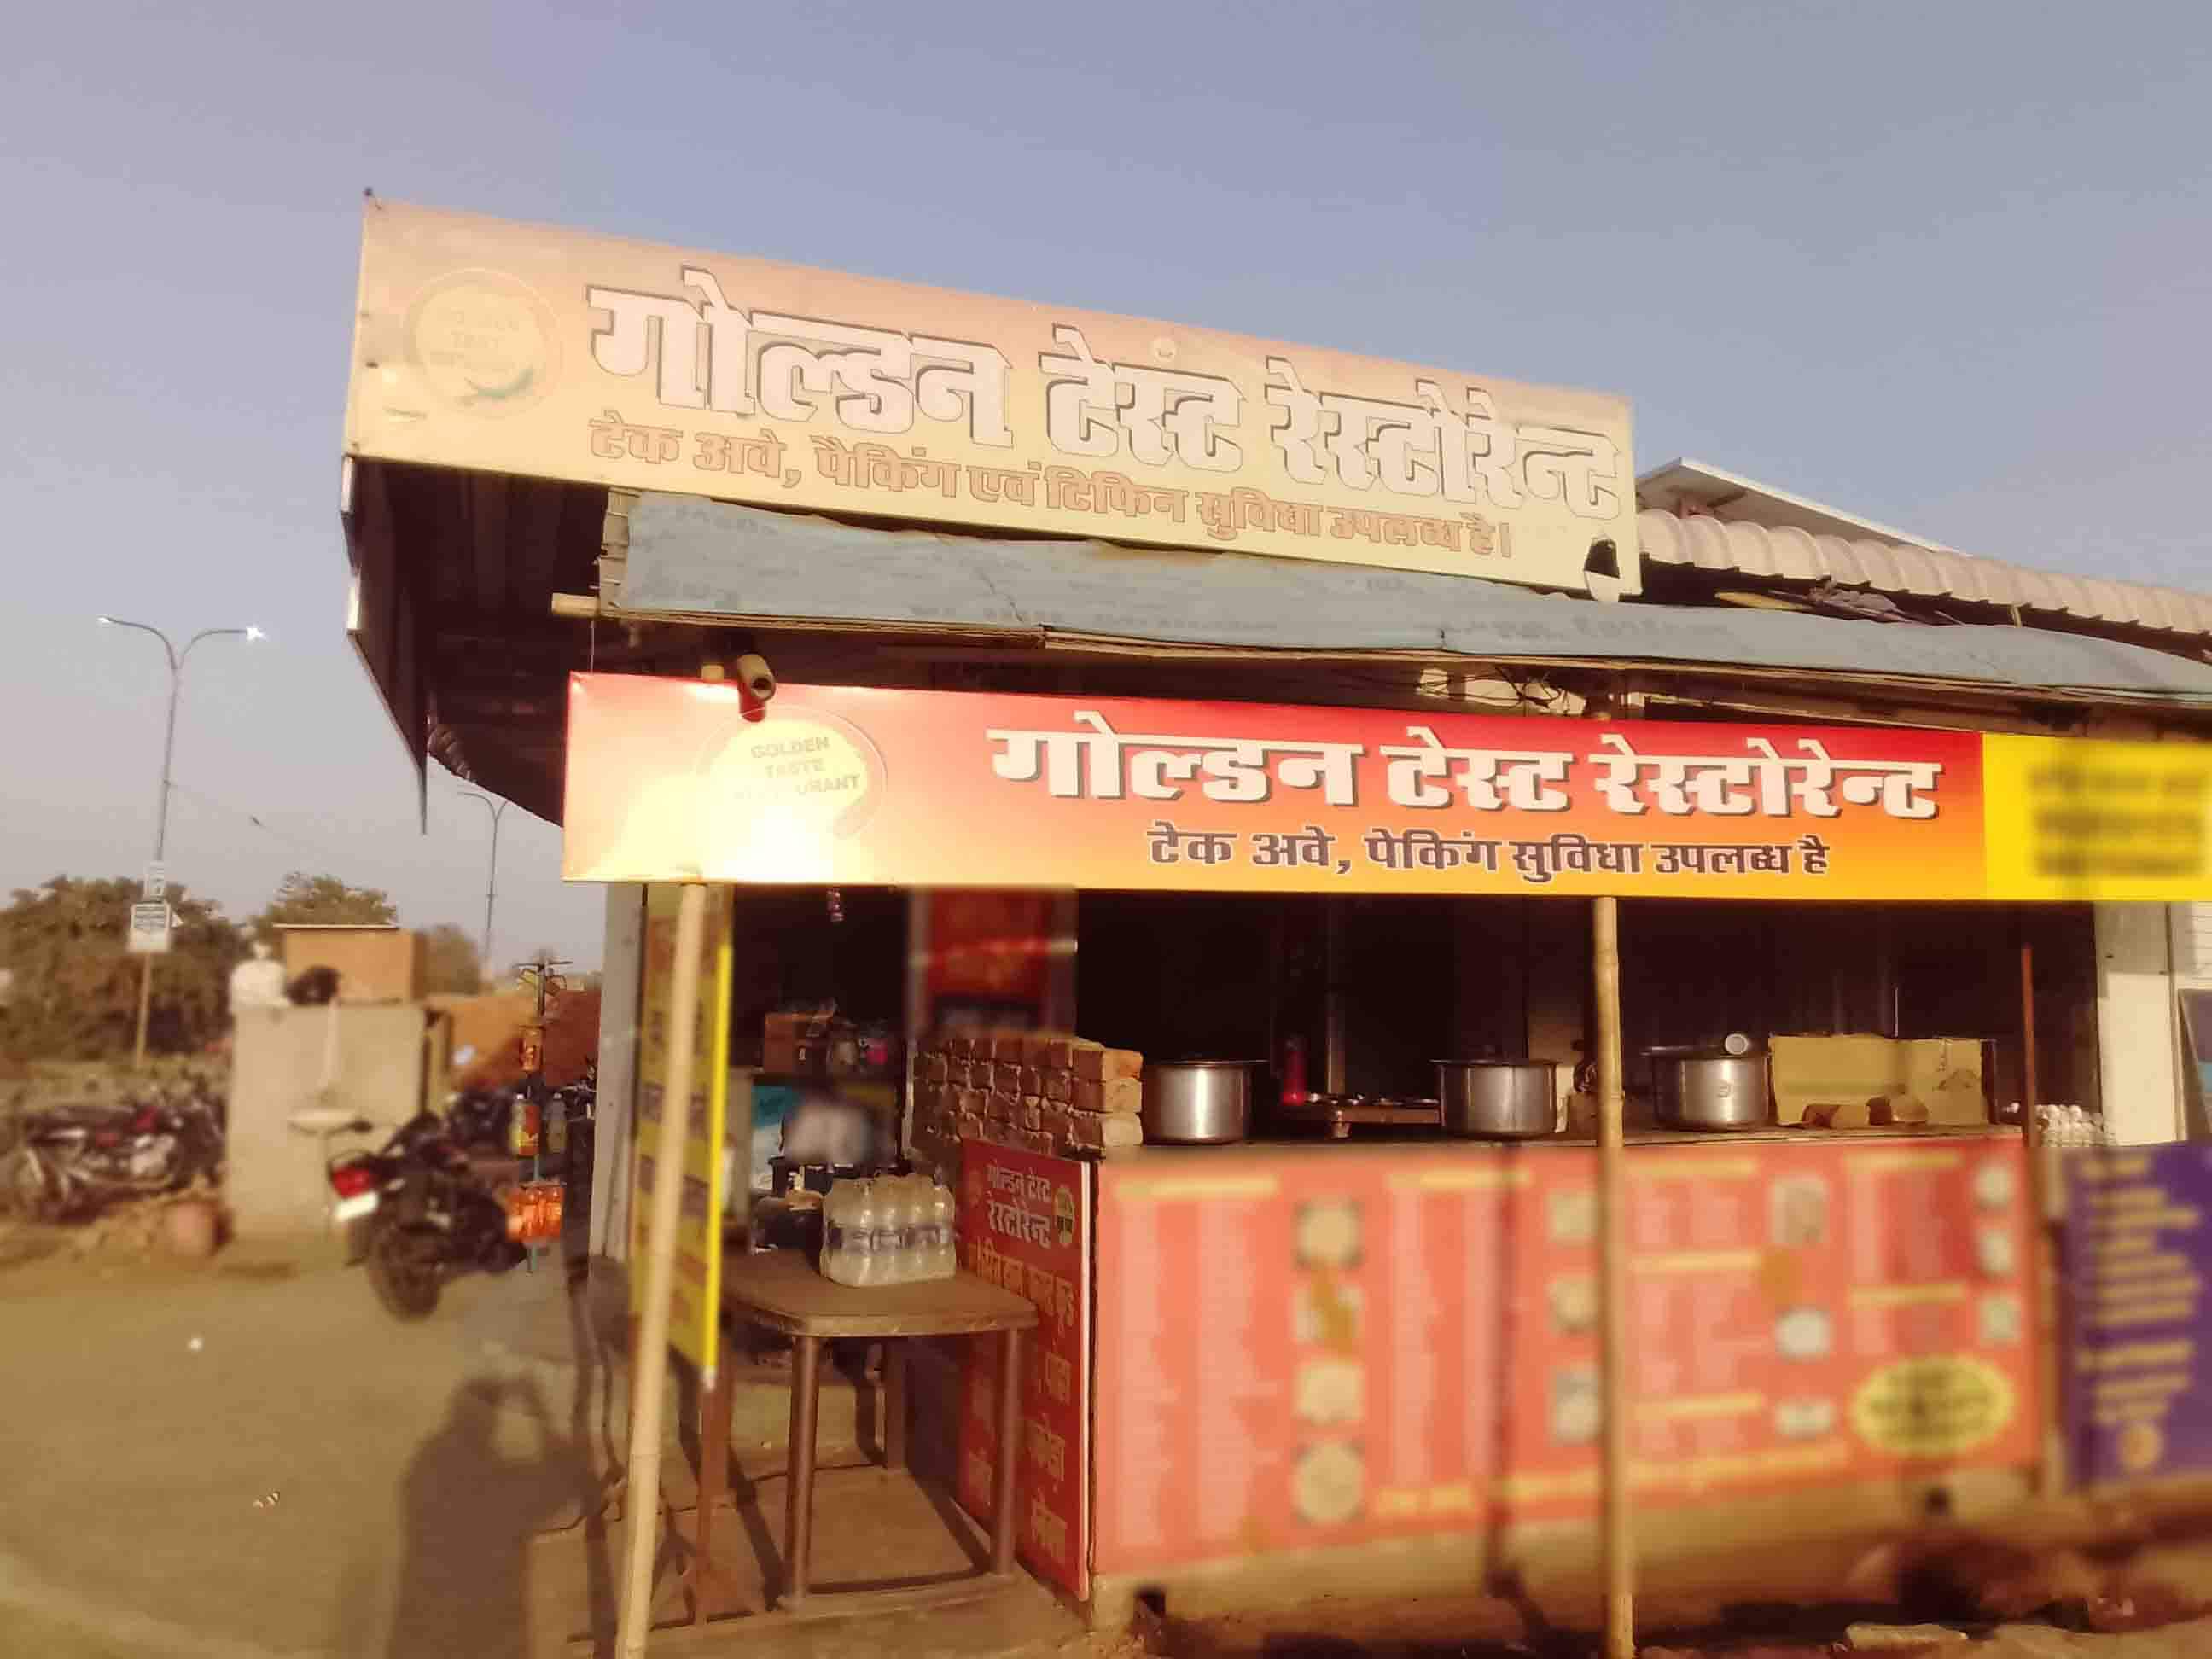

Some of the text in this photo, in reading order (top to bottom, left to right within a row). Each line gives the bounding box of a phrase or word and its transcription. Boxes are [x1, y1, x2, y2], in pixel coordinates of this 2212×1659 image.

[586, 263, 1622, 521] गोल्डन टेस्ट रेस्टोरेन्ट
[587, 408, 683, 464] टेक
[808, 434, 962, 498] पैकिंग
[965, 459, 1043, 507] एवं
[1044, 465, 1190, 523] टिफिन
[1195, 486, 1324, 541] सुविधा
[1325, 506, 1464, 552] उपलब्ध
[751, 736, 830, 758] GOLDEN
[987, 710, 1944, 819] गोल्डन टेस्ट रेस्टोरेन्ट
[1147, 820, 1237, 865] टेक
[1364, 828, 1502, 870] पेकिंग
[1508, 833, 1644, 882] सुविधा
[1651, 843, 1794, 874] उपलब्ध
[1797, 835, 1831, 874] है
